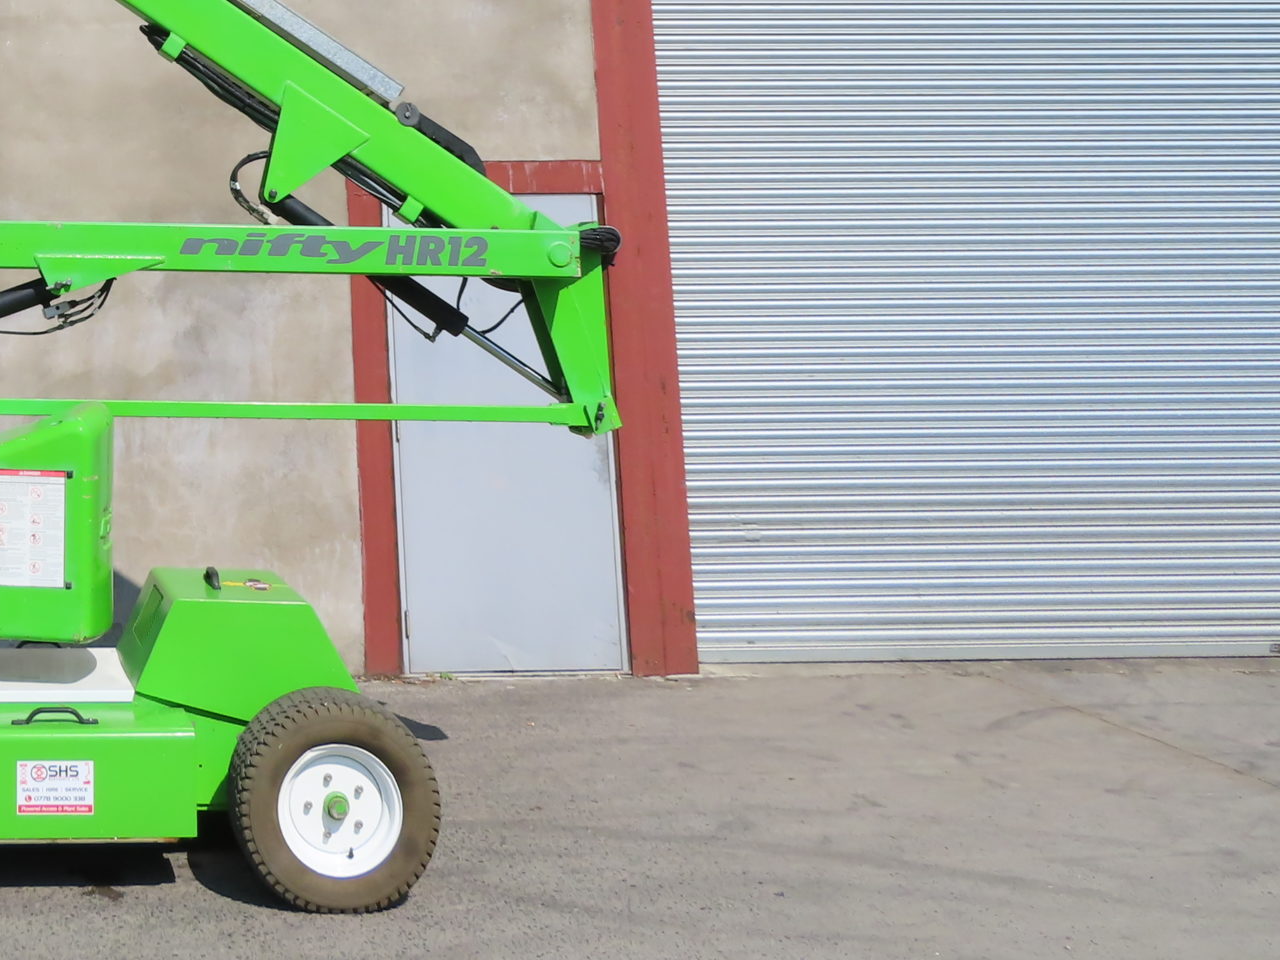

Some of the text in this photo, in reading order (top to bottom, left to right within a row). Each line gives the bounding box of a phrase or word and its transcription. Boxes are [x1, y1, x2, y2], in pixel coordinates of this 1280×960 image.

[179, 232, 489, 267] nifty HR12
[48, 765, 79, 777] SHS
